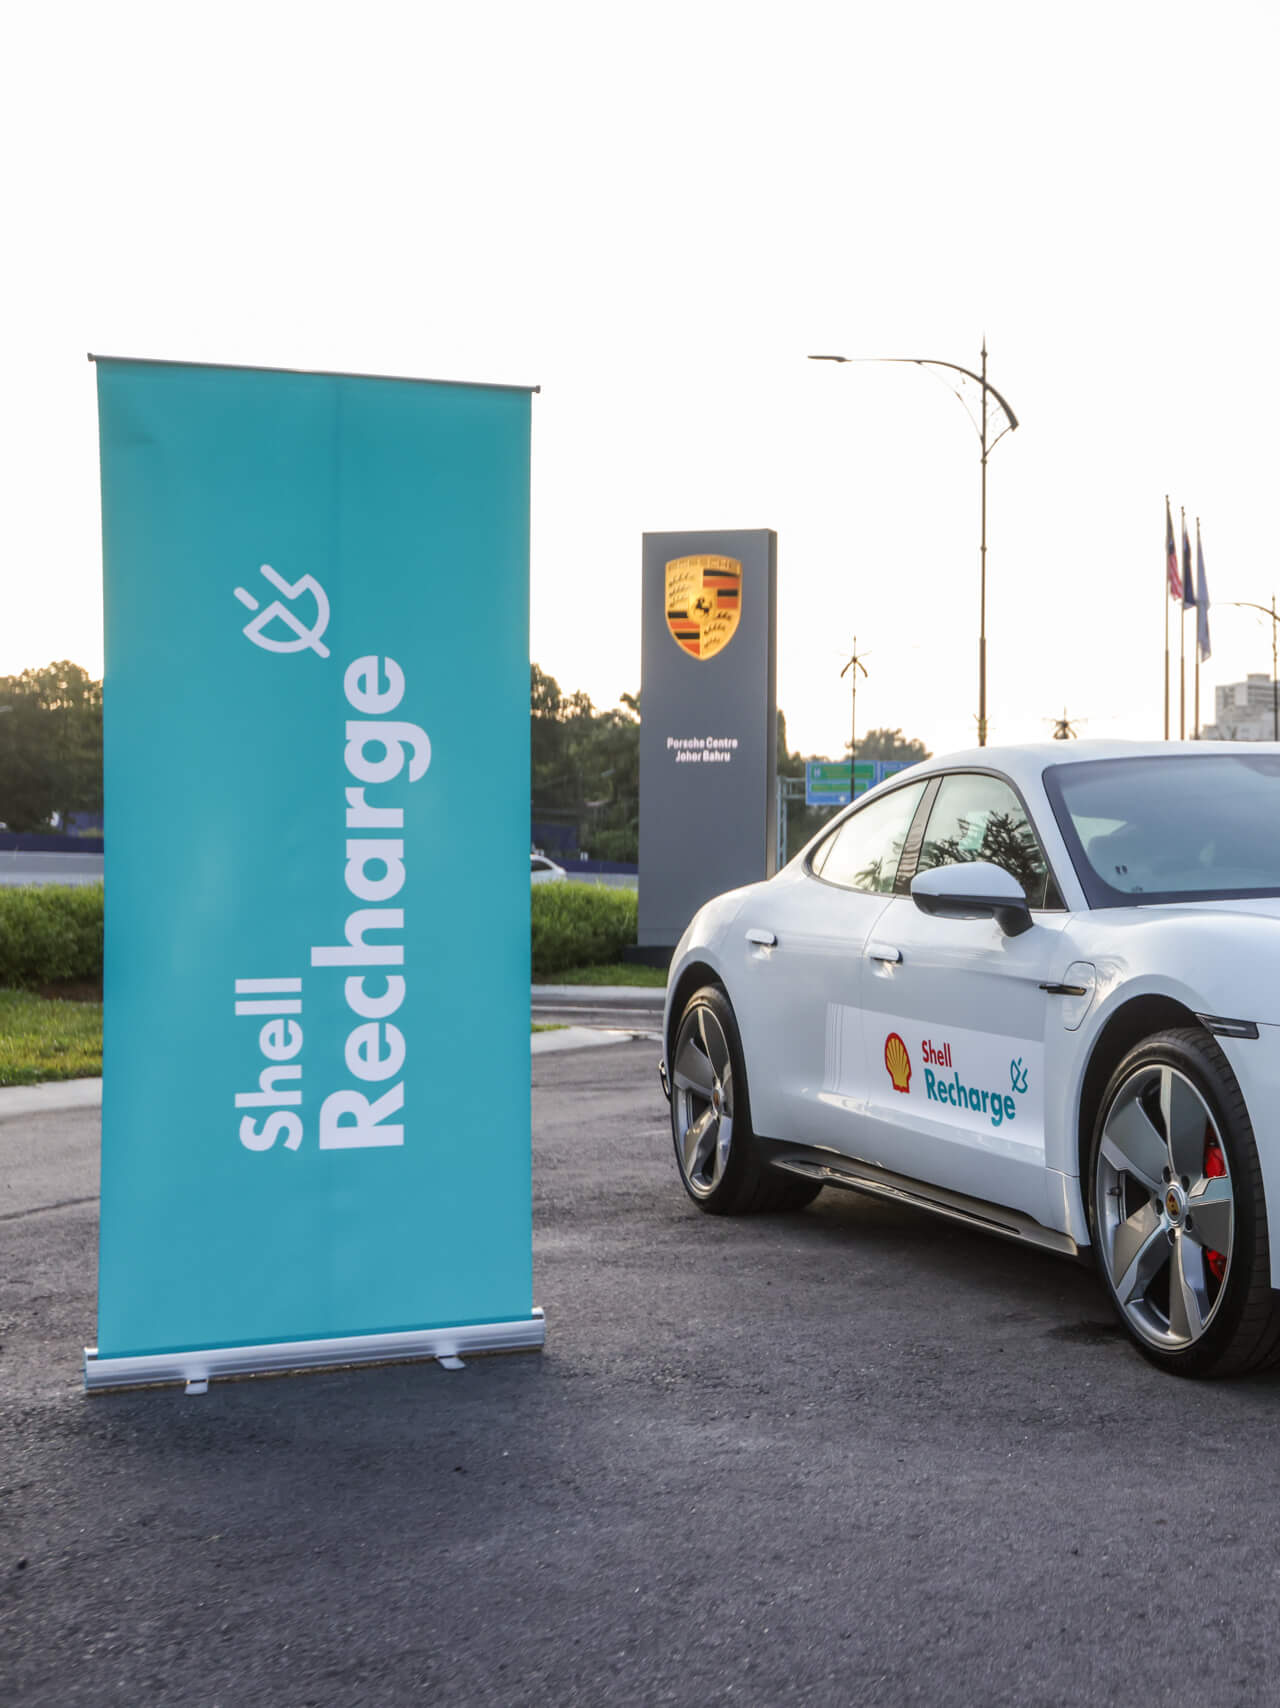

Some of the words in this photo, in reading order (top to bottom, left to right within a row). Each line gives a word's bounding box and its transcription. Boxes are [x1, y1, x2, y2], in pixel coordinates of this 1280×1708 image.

[667, 736, 705, 749] Porsche
[706, 736, 738, 749] Centre
[675, 750, 702, 763] Johor
[703, 750, 731, 762] Bahru
[311, 654, 432, 1151] Recharge
[235, 977, 303, 1152] Shell
[922, 1039, 953, 1068] Shell
[924, 1067, 1017, 1127] Recharge
